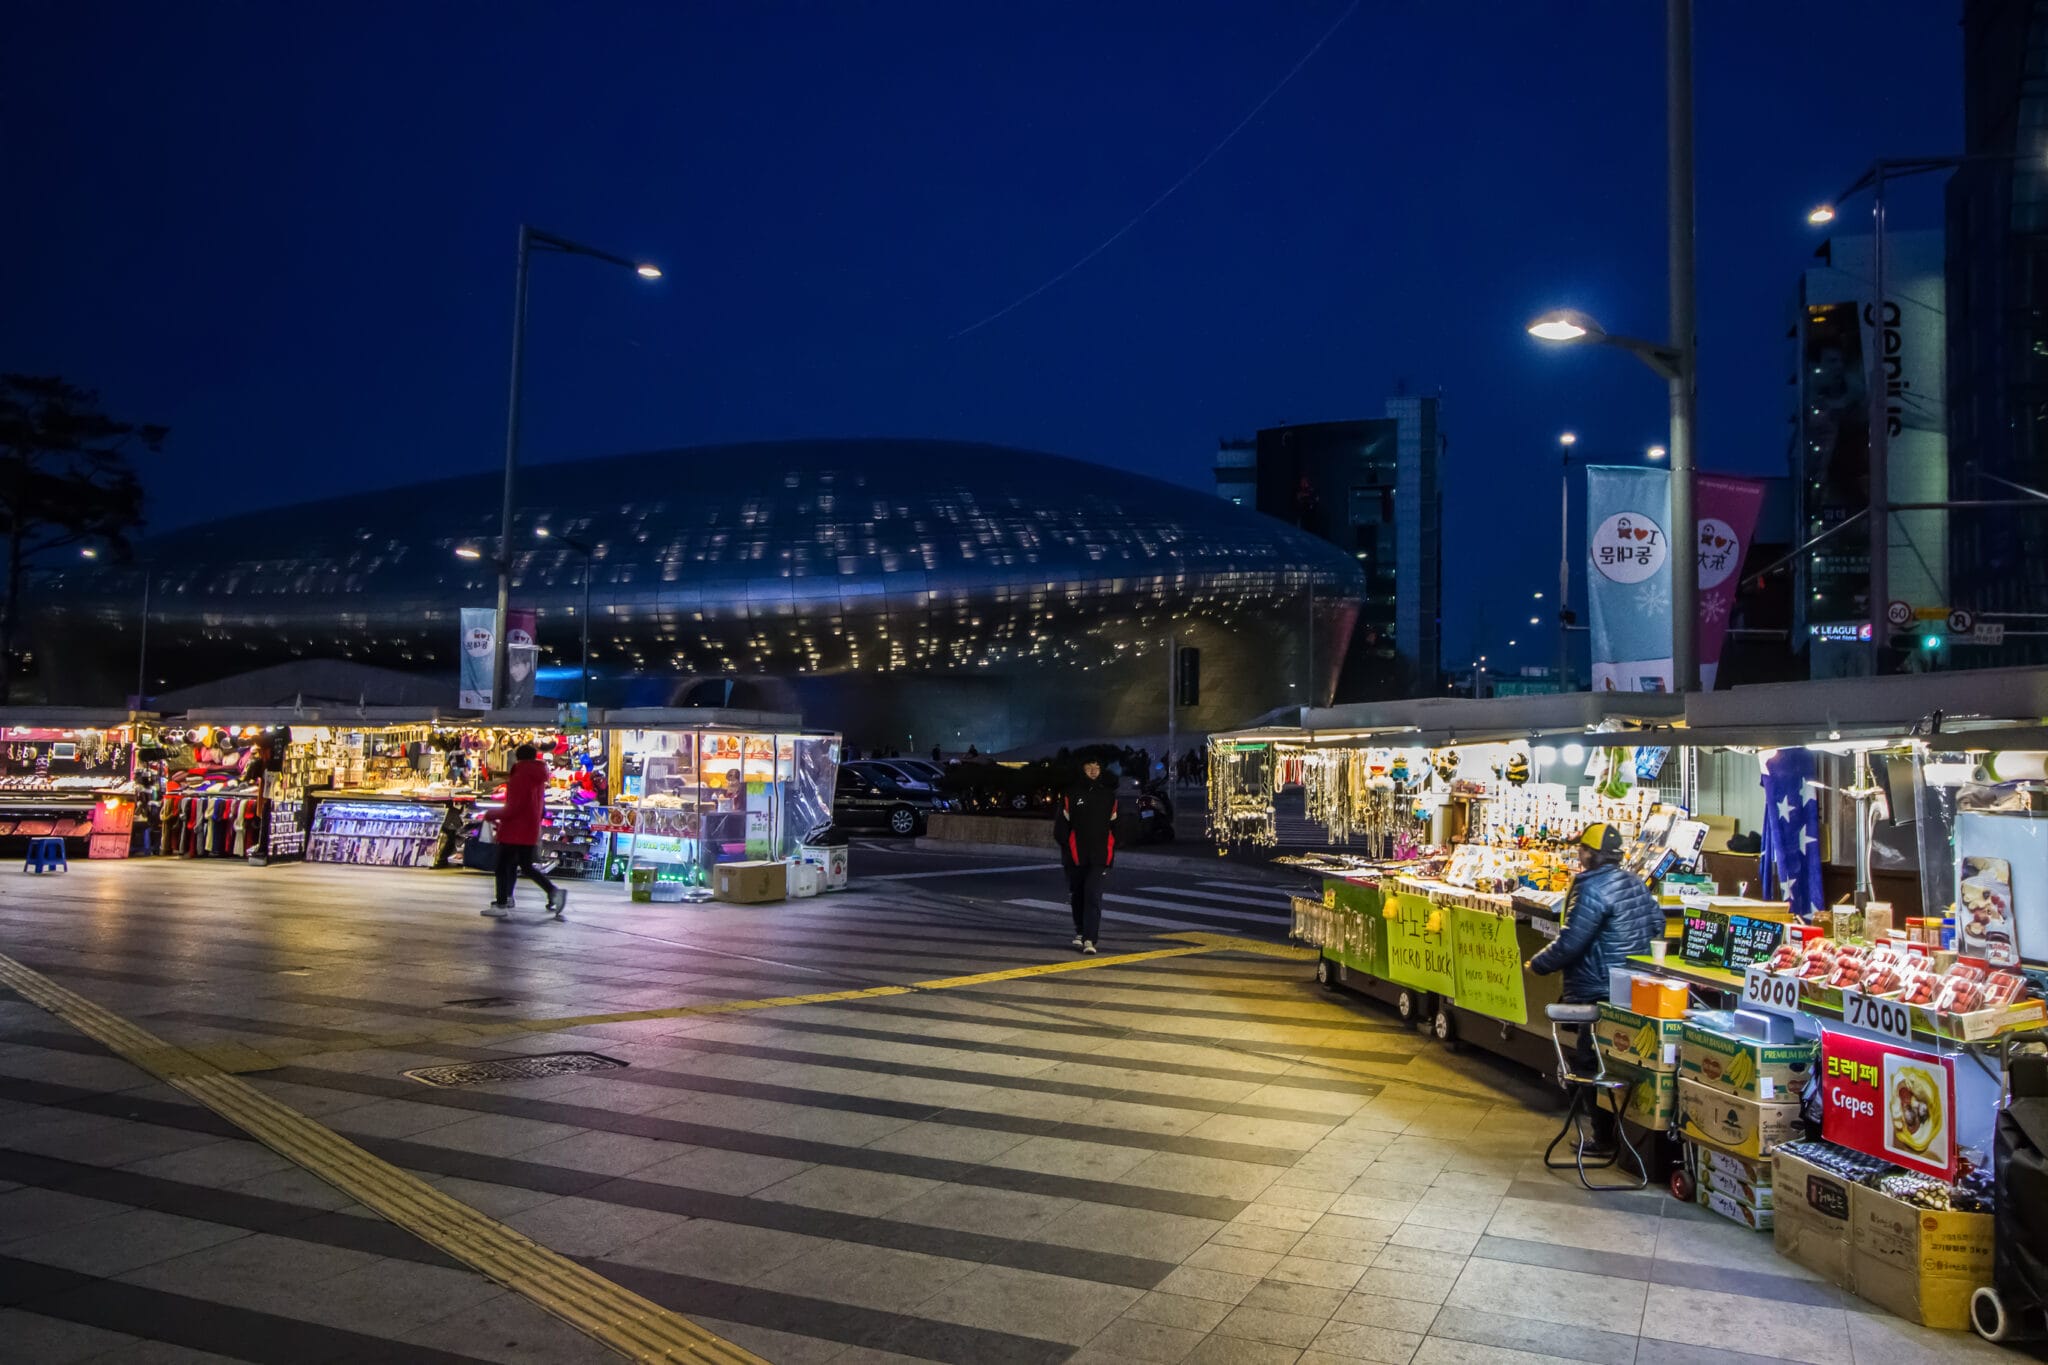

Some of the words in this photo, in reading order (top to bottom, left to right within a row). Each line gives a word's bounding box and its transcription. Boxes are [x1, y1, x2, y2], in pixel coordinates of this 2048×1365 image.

[1890, 607, 1907, 620] 60
[1811, 625, 1819, 634] K
[1821, 625, 1857, 635] LEAGUE
[1392, 946, 1421, 969] MICRO
[1764, 1050, 1797, 1060] PREMIUM
[1828, 1055, 1878, 1089] 크레페
[1832, 1086, 1874, 1119] Crepes
